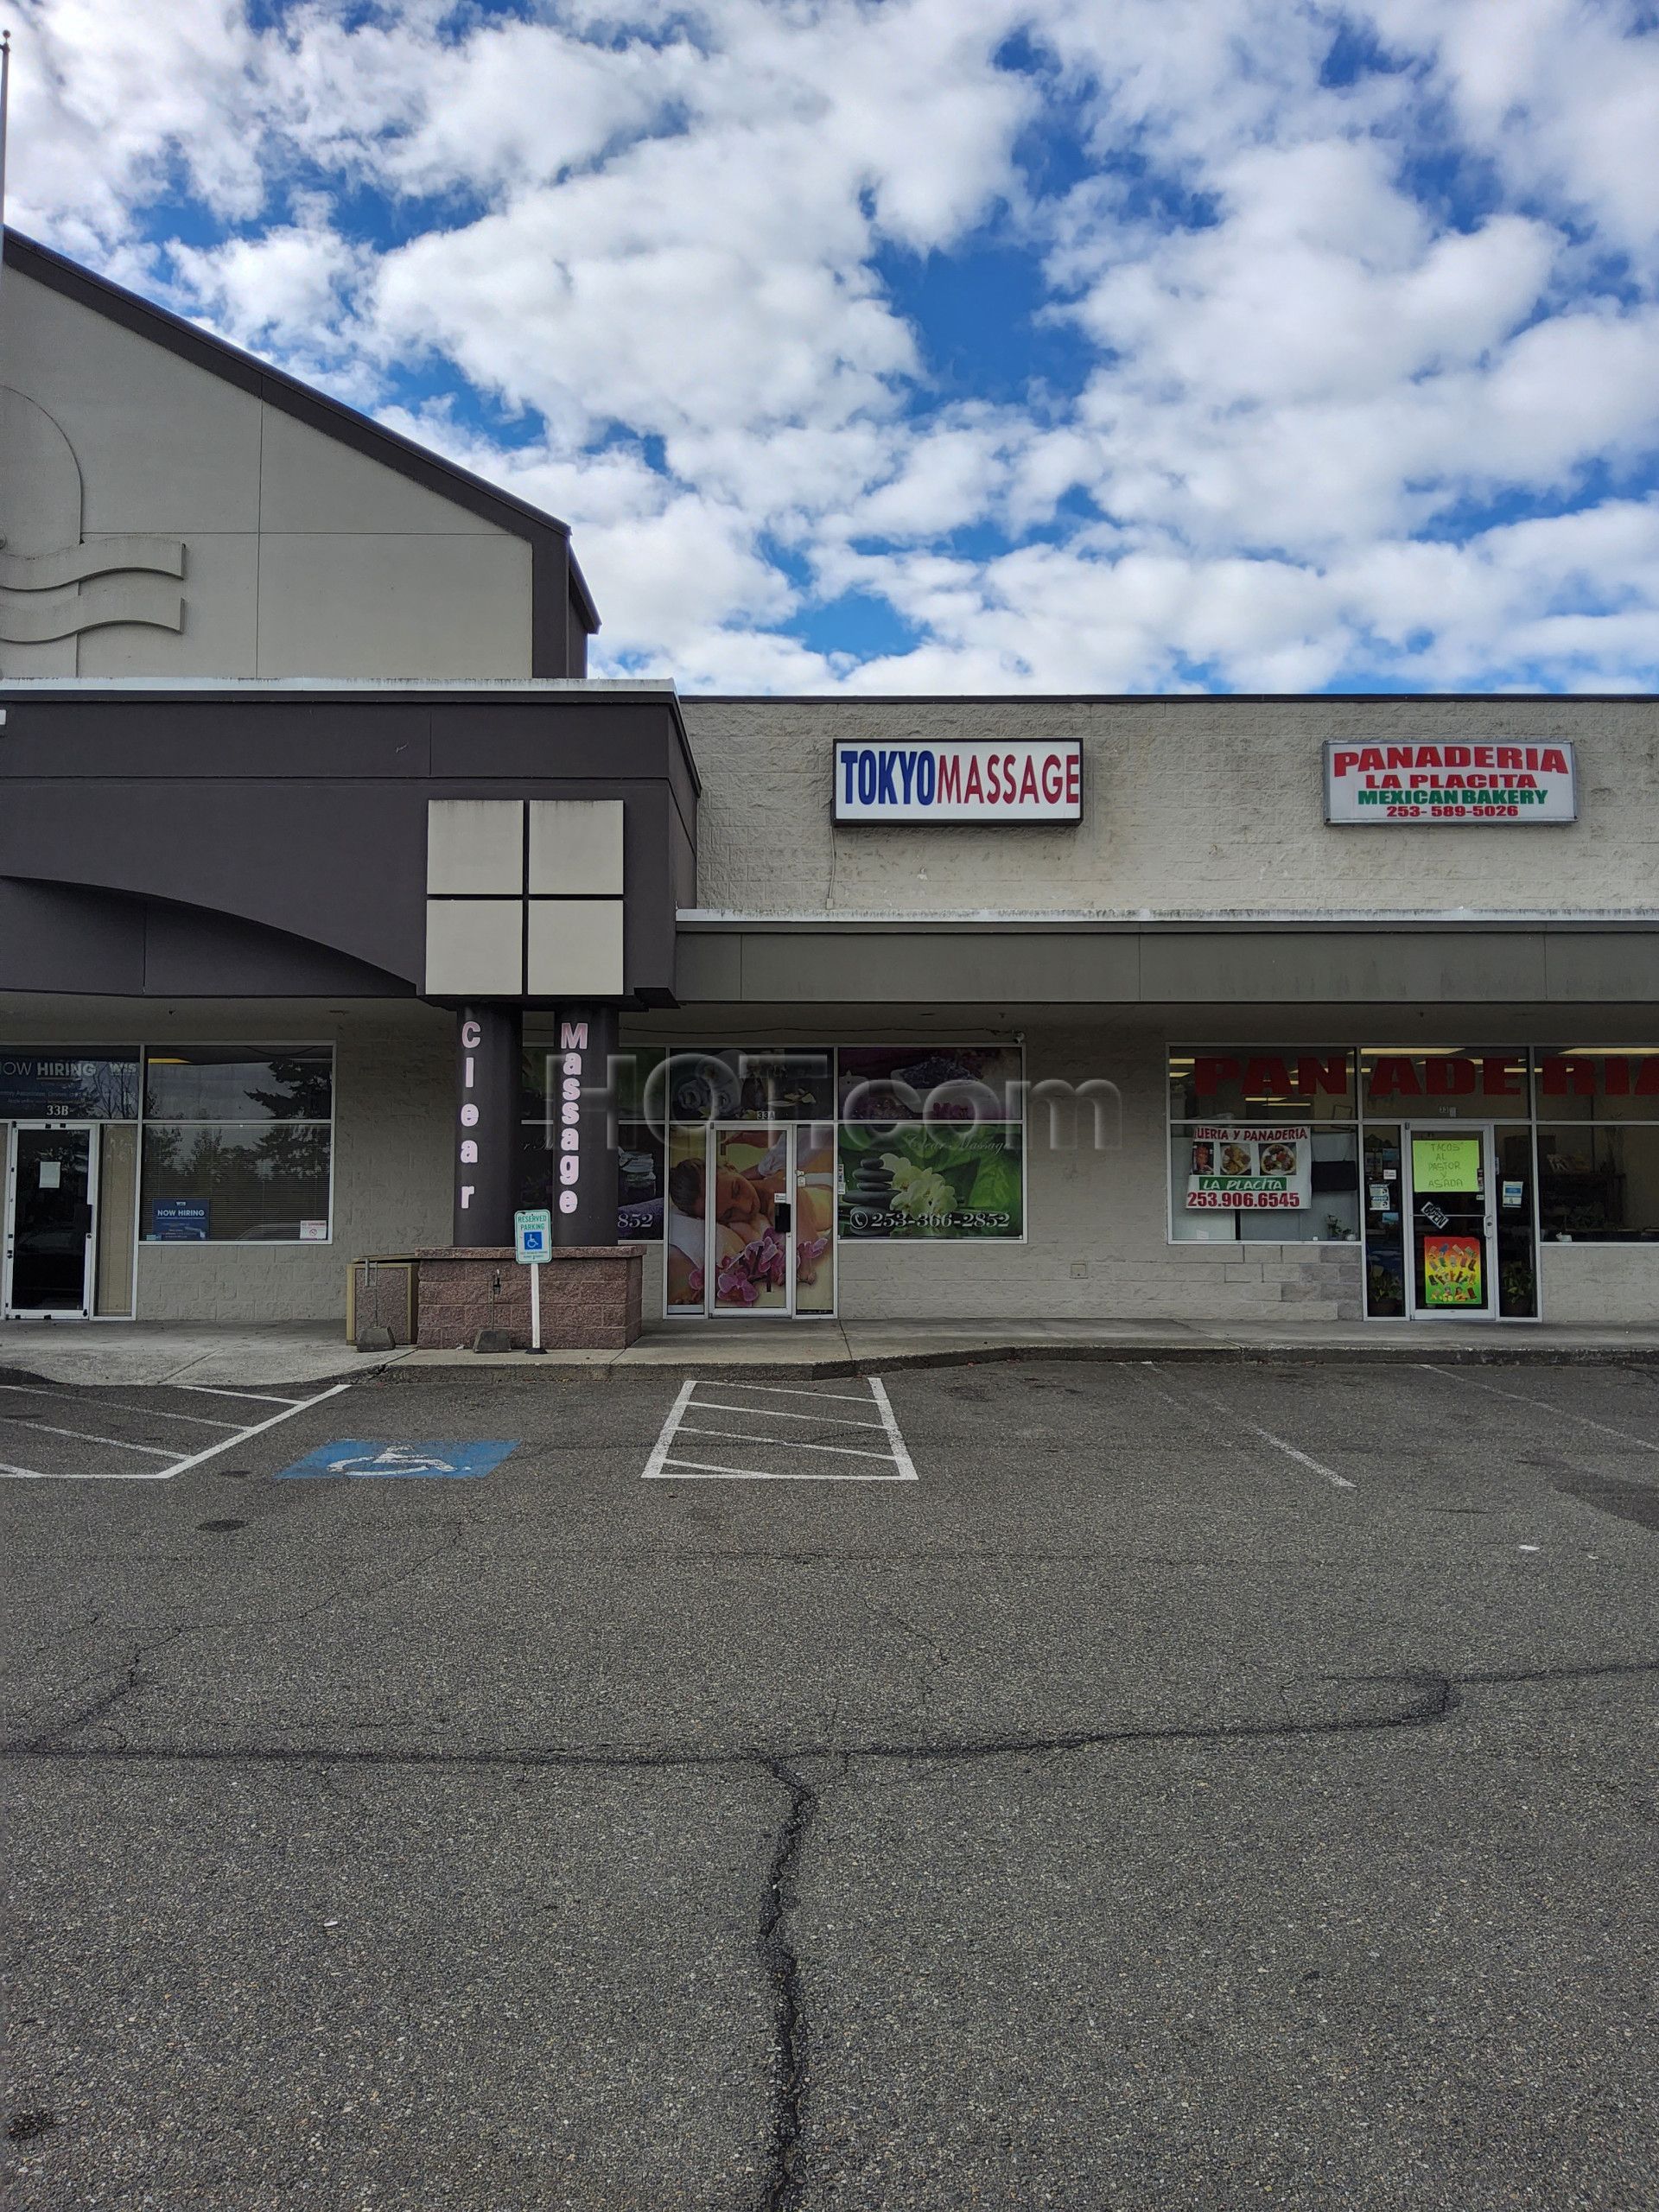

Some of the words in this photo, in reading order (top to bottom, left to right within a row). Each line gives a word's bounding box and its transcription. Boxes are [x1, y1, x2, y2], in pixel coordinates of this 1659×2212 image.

[1333, 746, 1569, 777] PANADERIA
[840, 749, 936, 805] TOKYO
[937, 754, 1079, 804] MASSAGE
[1366, 774, 1402, 788] LA
[1409, 773, 1538, 788] PLACITA
[1357, 790, 1461, 805] MEXICAN
[1462, 789, 1548, 804] BAKERY
[0, 1061, 32, 1076] OW
[37, 1062, 97, 1077] HIRING
[460, 1020, 481, 1209] Clear
[559, 1022, 588, 1214] Massage
[757, 1110, 775, 1120] 33A
[1194, 1127, 1229, 1141] UERIA
[1244, 1127, 1308, 1141] PANADERIA
[1202, 1179, 1220, 1190] LA
[1428, 1179, 1463, 1188] ASADA
[1186, 1192, 1300, 1207] 253.906.6545
[518, 1215, 547, 1224] RESERVED
[520, 1223, 545, 1231] PARKING
[871, 1212, 1010, 1227] 253-366-2852
